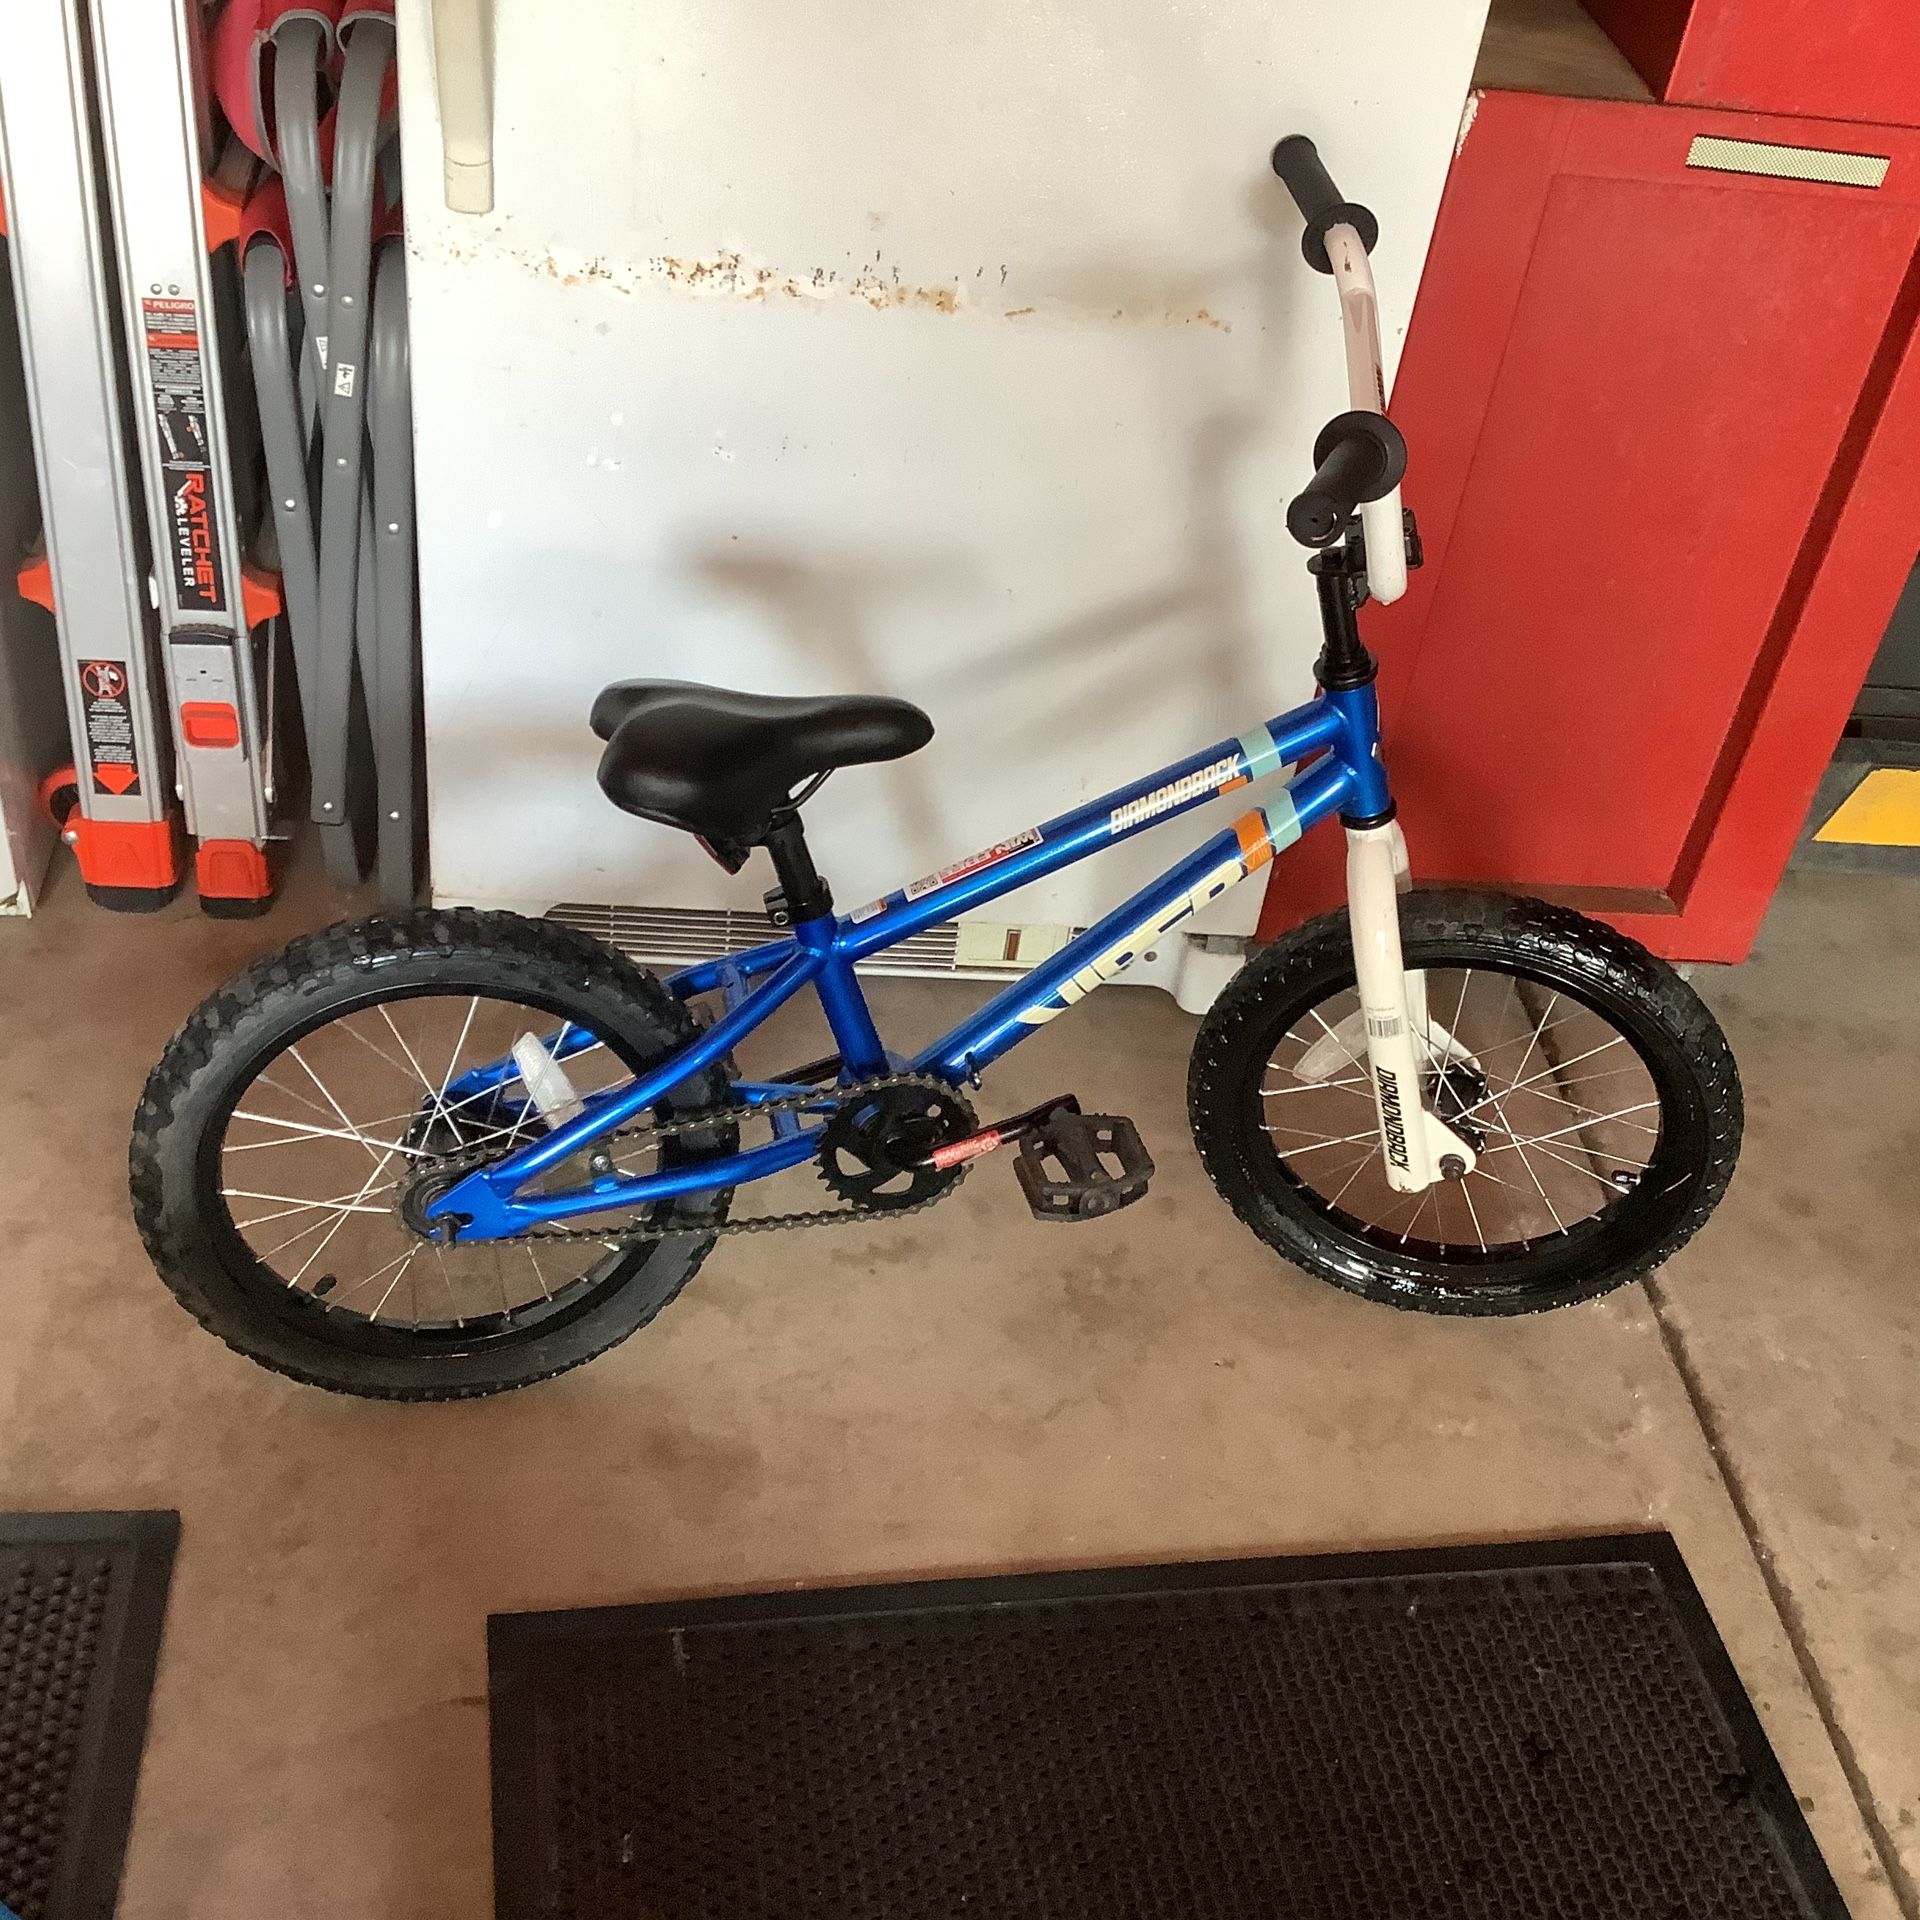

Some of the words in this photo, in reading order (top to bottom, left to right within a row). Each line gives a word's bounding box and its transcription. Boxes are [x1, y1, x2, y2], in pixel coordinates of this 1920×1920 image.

[152, 300, 195, 310] PELIGRO
[176, 517, 196, 588] LEVELER
[182, 473, 217, 604] RATCHET
[1111, 753, 1241, 835] DIAMONDBACK
[1376, 1065, 1411, 1173] DIAMONDBACK
